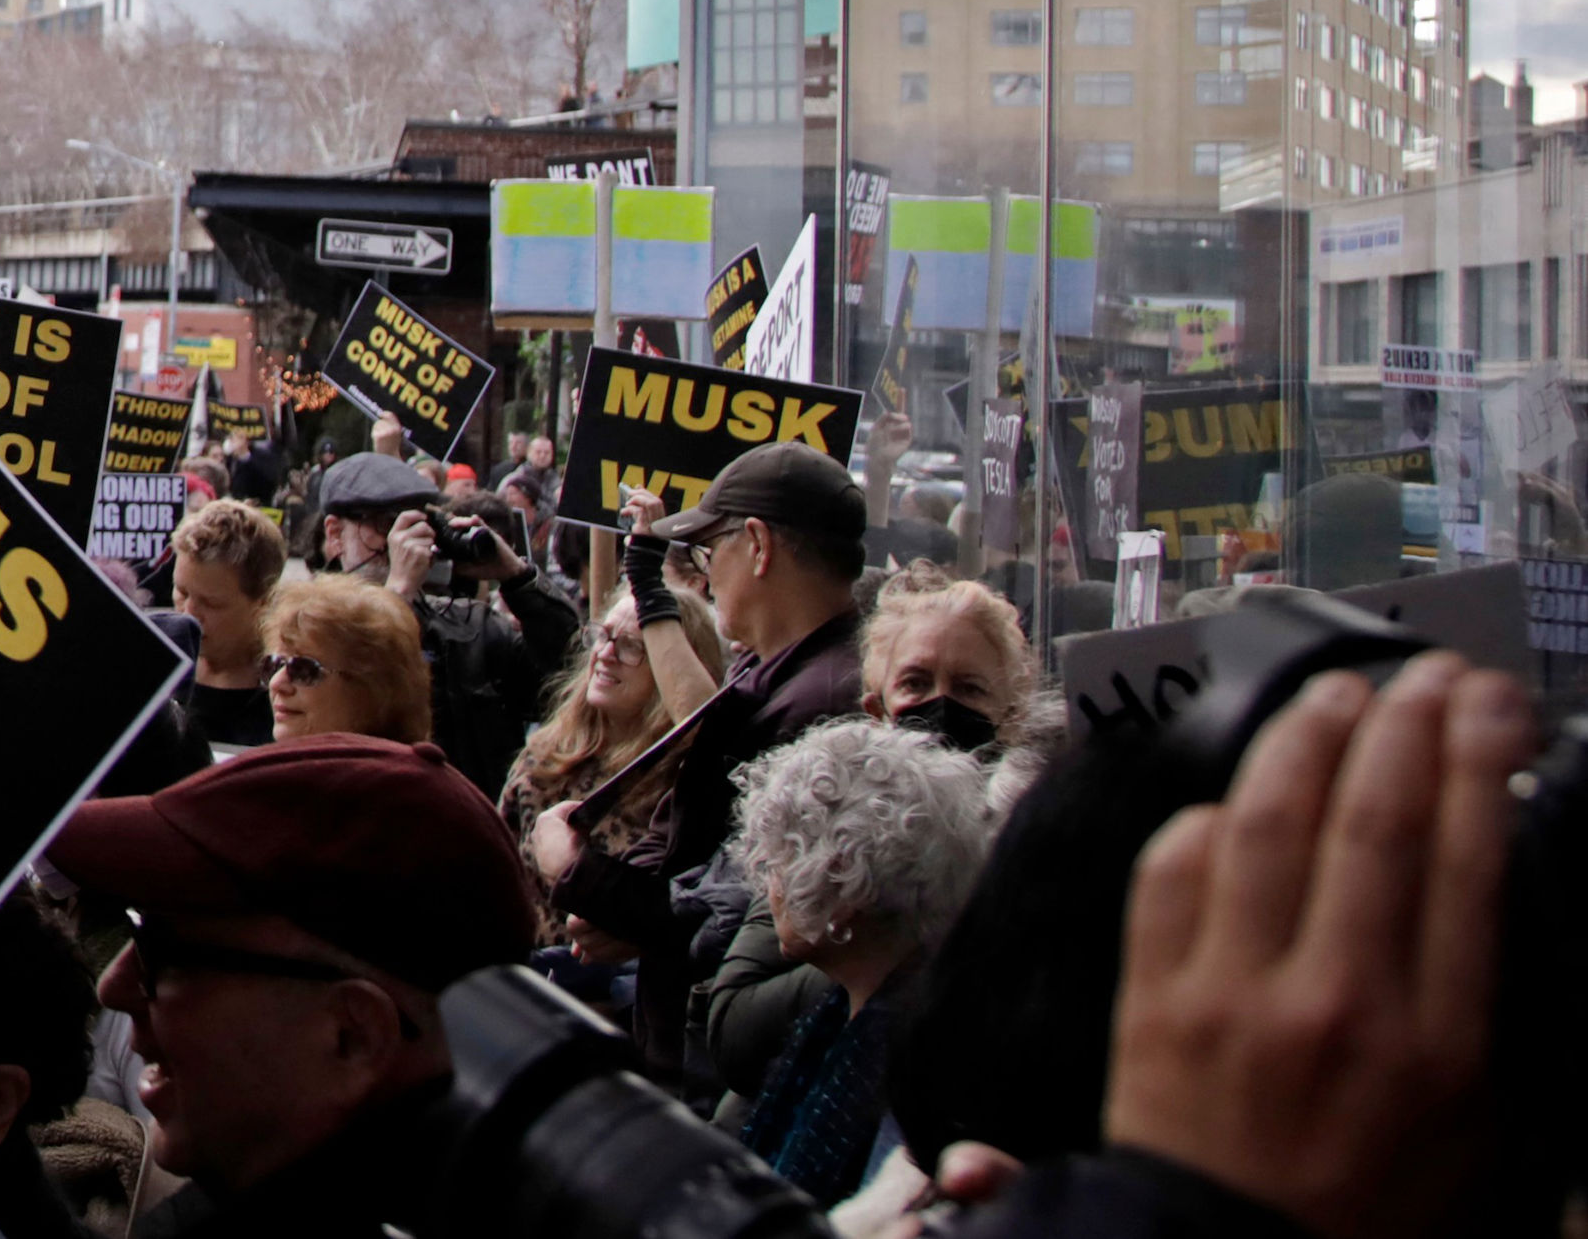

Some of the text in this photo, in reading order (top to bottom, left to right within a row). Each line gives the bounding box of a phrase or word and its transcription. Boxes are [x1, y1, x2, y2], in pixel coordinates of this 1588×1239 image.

[331, 233, 433, 260] ONE WAY
[742, 256, 758, 285] A
[13, 313, 73, 364] IS
[375, 296, 473, 379] MUSK IS
[368, 324, 455, 397] OUT OF
[345, 339, 451, 433] CONTROL
[114, 394, 190, 421] THROW
[602, 365, 839, 455] MUSK
[982, 402, 1022, 447] BOYCOTT
[109, 423, 182, 447] HADOW
[1093, 435, 1125, 472] VOTED
[600, 458, 714, 513] WT
[981, 458, 1011, 498] TESLA
[1095, 477, 1114, 506] FOR
[125, 503, 175, 531] OUR
